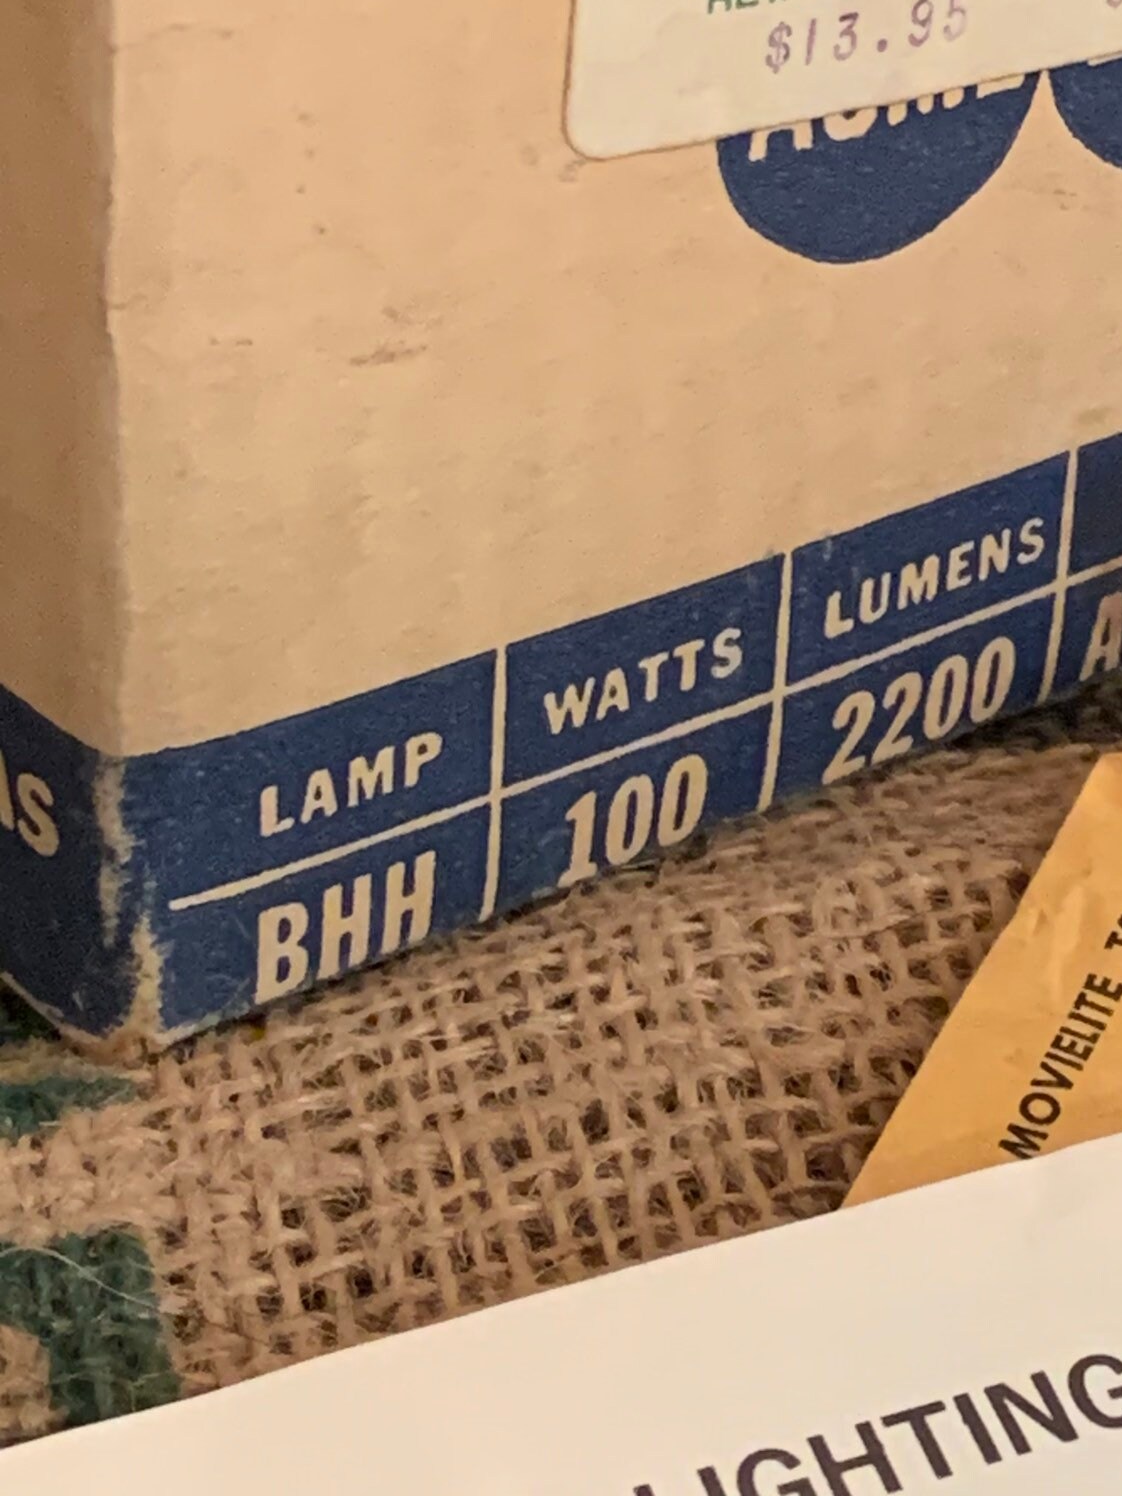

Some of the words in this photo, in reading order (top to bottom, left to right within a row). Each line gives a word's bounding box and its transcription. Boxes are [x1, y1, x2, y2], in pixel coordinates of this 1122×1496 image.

[823, 517, 1045, 638] LUMENS
[544, 628, 743, 735] WATTS
[822, 637, 1016, 784] 2200
[260, 730, 443, 837] LAMP
[559, 754, 708, 888] 100
[254, 850, 436, 1005] BHH
